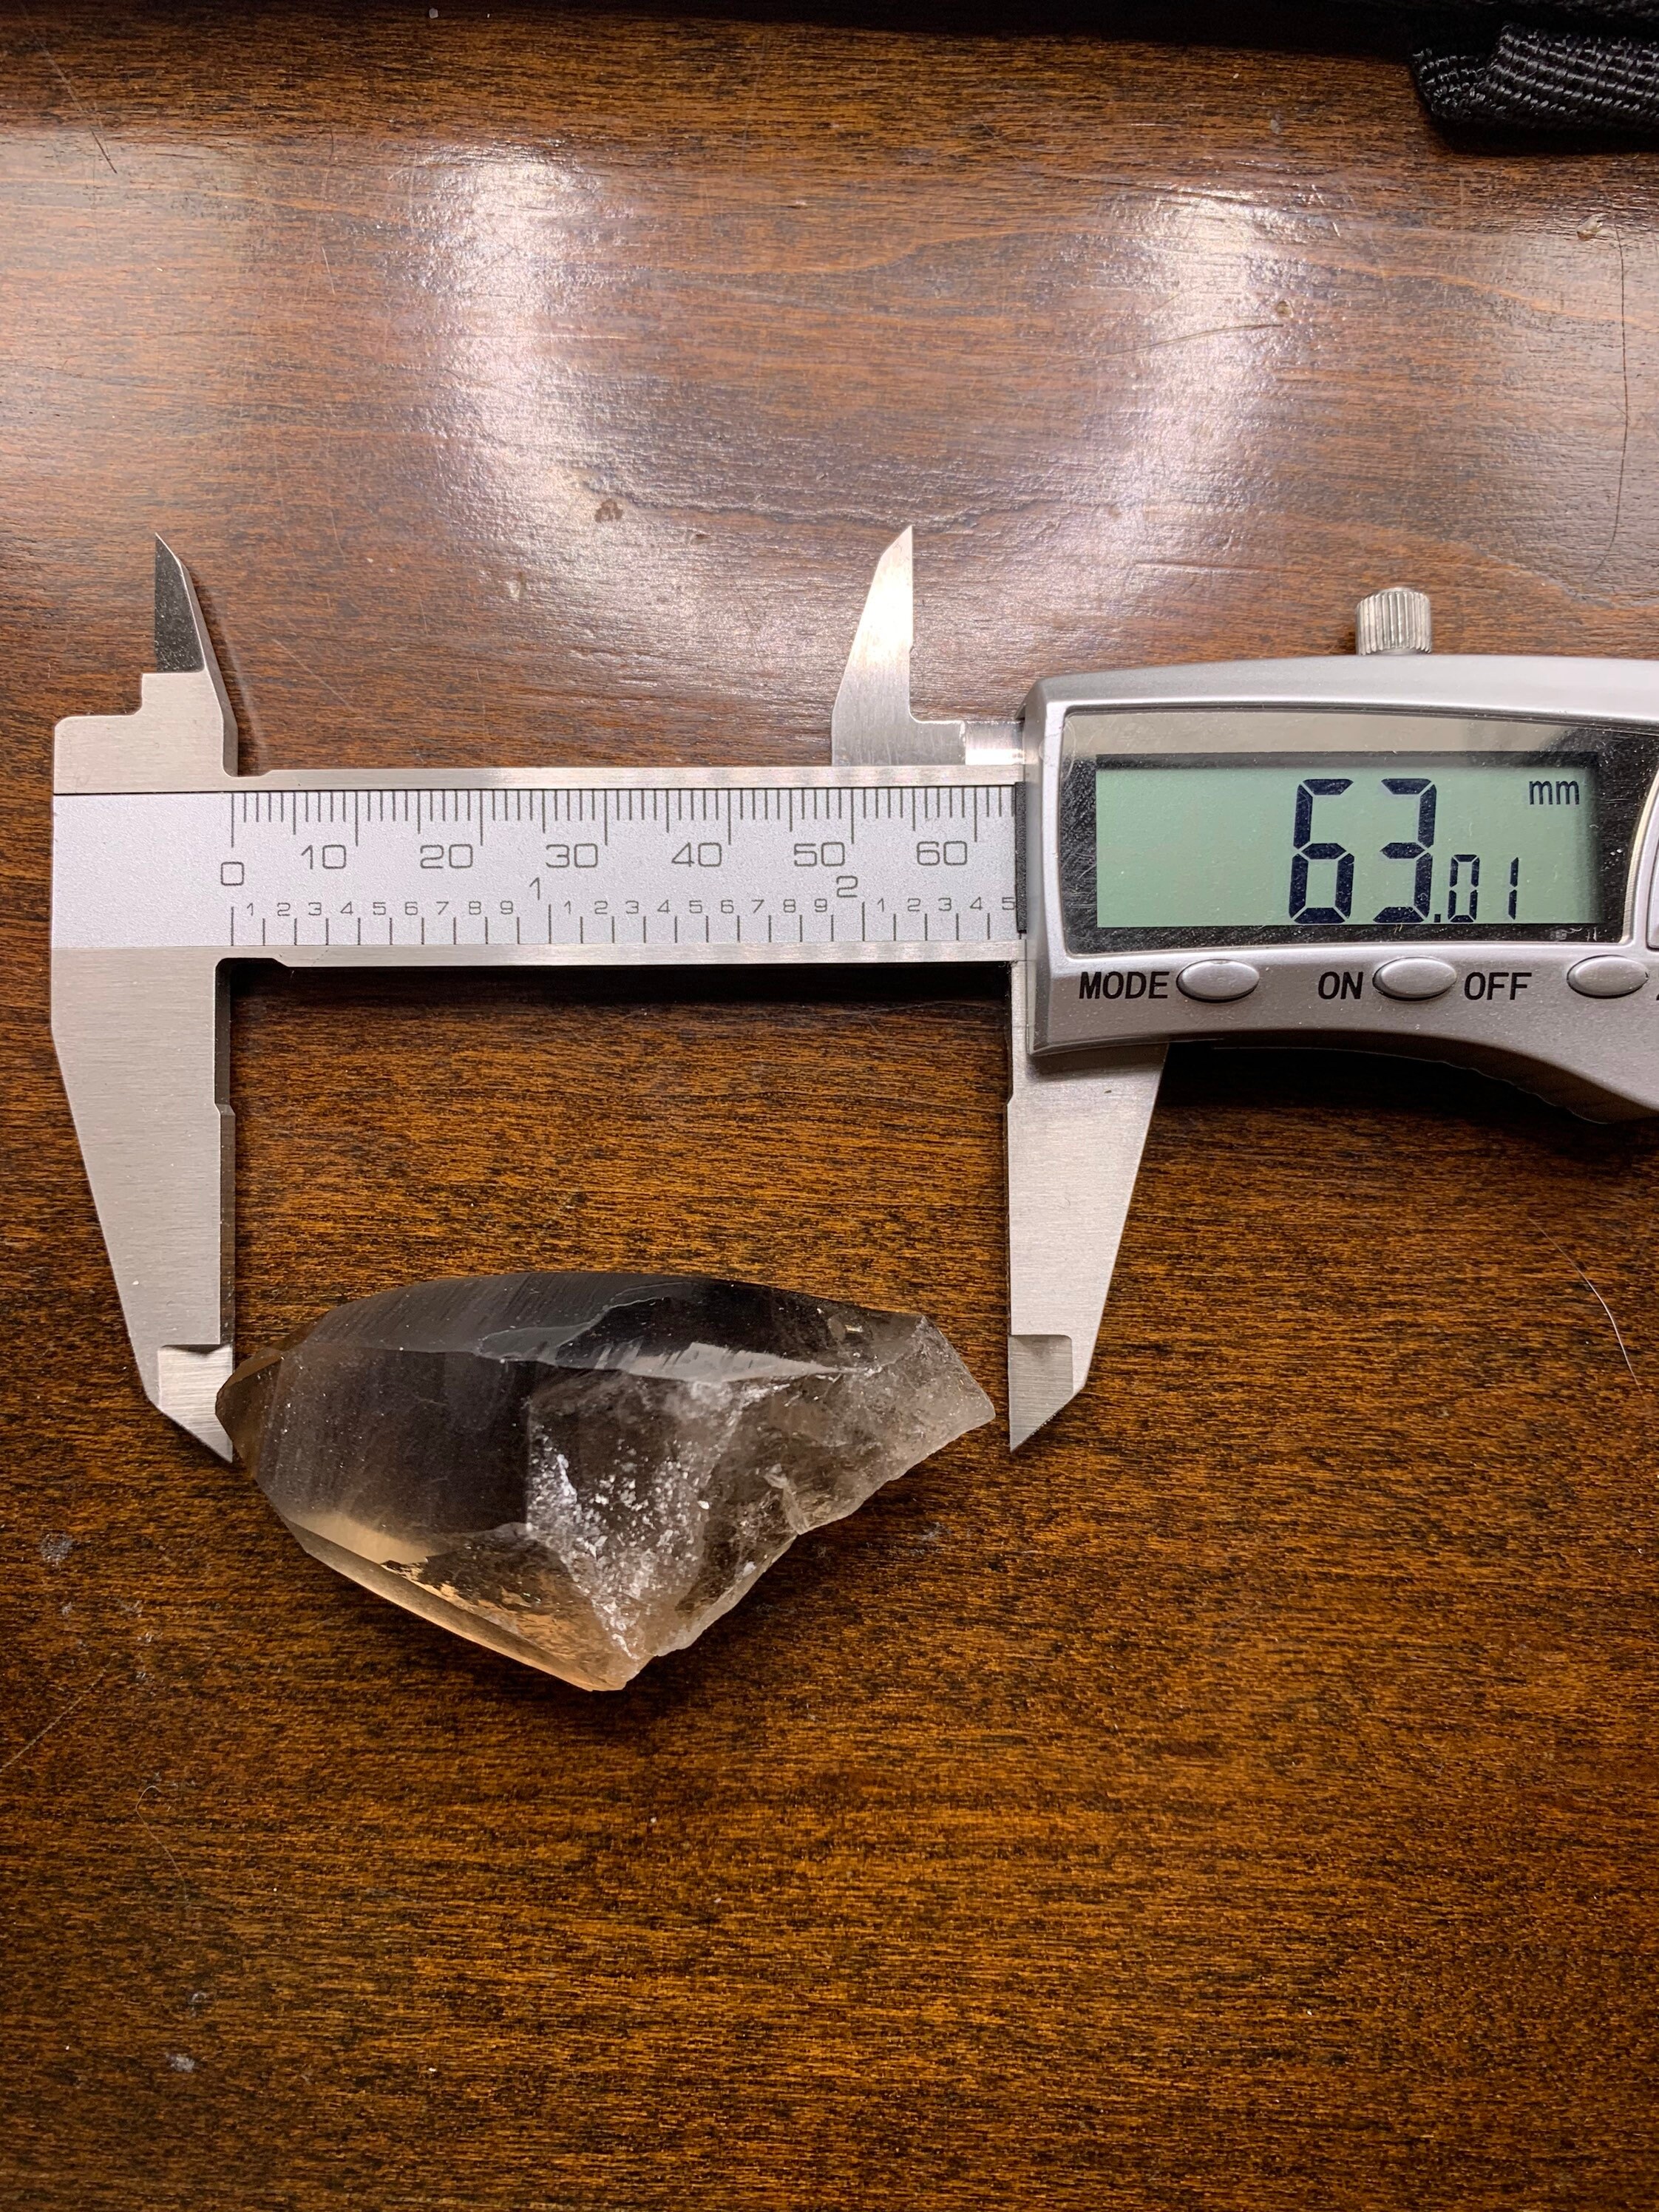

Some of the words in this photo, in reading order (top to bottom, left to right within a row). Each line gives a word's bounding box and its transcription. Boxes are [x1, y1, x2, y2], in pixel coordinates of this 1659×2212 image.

[301, 844, 347, 869] 10
[420, 844, 474, 869] 20
[546, 843, 599, 869] 30
[671, 842, 723, 868] 40
[794, 841, 846, 867] 50
[916, 841, 968, 866] 60
[1289, 778, 1519, 925] 63.01
[1528, 779, 1581, 807] mm
[220, 861, 245, 886] 0
[529, 877, 540, 900] 1
[836, 875, 859, 899] 2
[247, 903, 254, 916] 1
[277, 903, 291, 917] 2
[308, 902, 322, 916] 3
[339, 901, 353, 915] 4
[373, 902, 387, 916] 5
[405, 901, 418, 915] 6
[436, 901, 449, 915] 7
[468, 901, 482, 915] 8
[501, 900, 514, 915] 9
[564, 900, 571, 915] 1
[594, 900, 608, 915] 2
[625, 900, 639, 915] 3
[657, 900, 671, 914] 4
[689, 900, 702, 914] 5
[721, 900, 734, 914] 6
[752, 899, 765, 914] 7
[783, 899, 796, 914] 8
[815, 898, 828, 913] 9
[878, 898, 885, 912] 1
[908, 898, 921, 912] 2
[938, 898, 952, 912] 3
[970, 897, 983, 911] 4
[1002, 897, 1015, 911] 5
[1079, 971, 1170, 1000] MODE
[1317, 971, 1363, 1000] ON
[1464, 971, 1533, 1001] OFF
